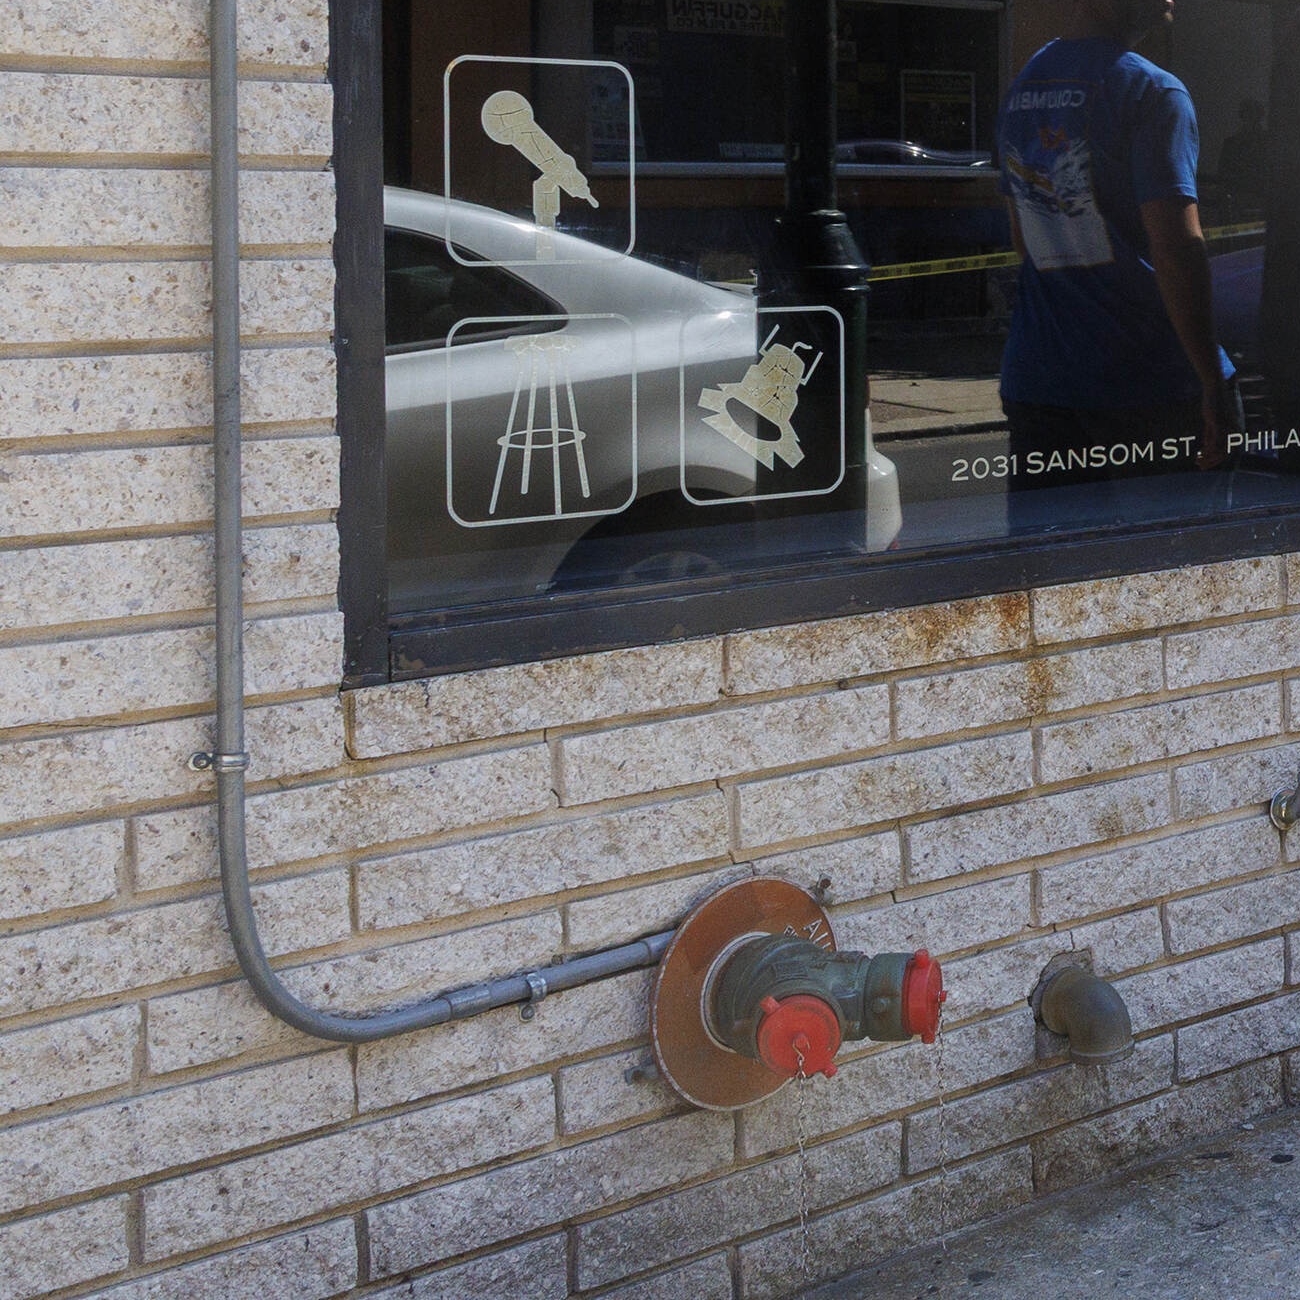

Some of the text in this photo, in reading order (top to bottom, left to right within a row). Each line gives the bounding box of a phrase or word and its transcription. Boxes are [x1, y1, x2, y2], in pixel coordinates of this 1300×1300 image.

[952, 456, 1017, 482] 2031
[1025, 442, 1155, 475] SANSOM
[1161, 435, 1203, 460] ST.
